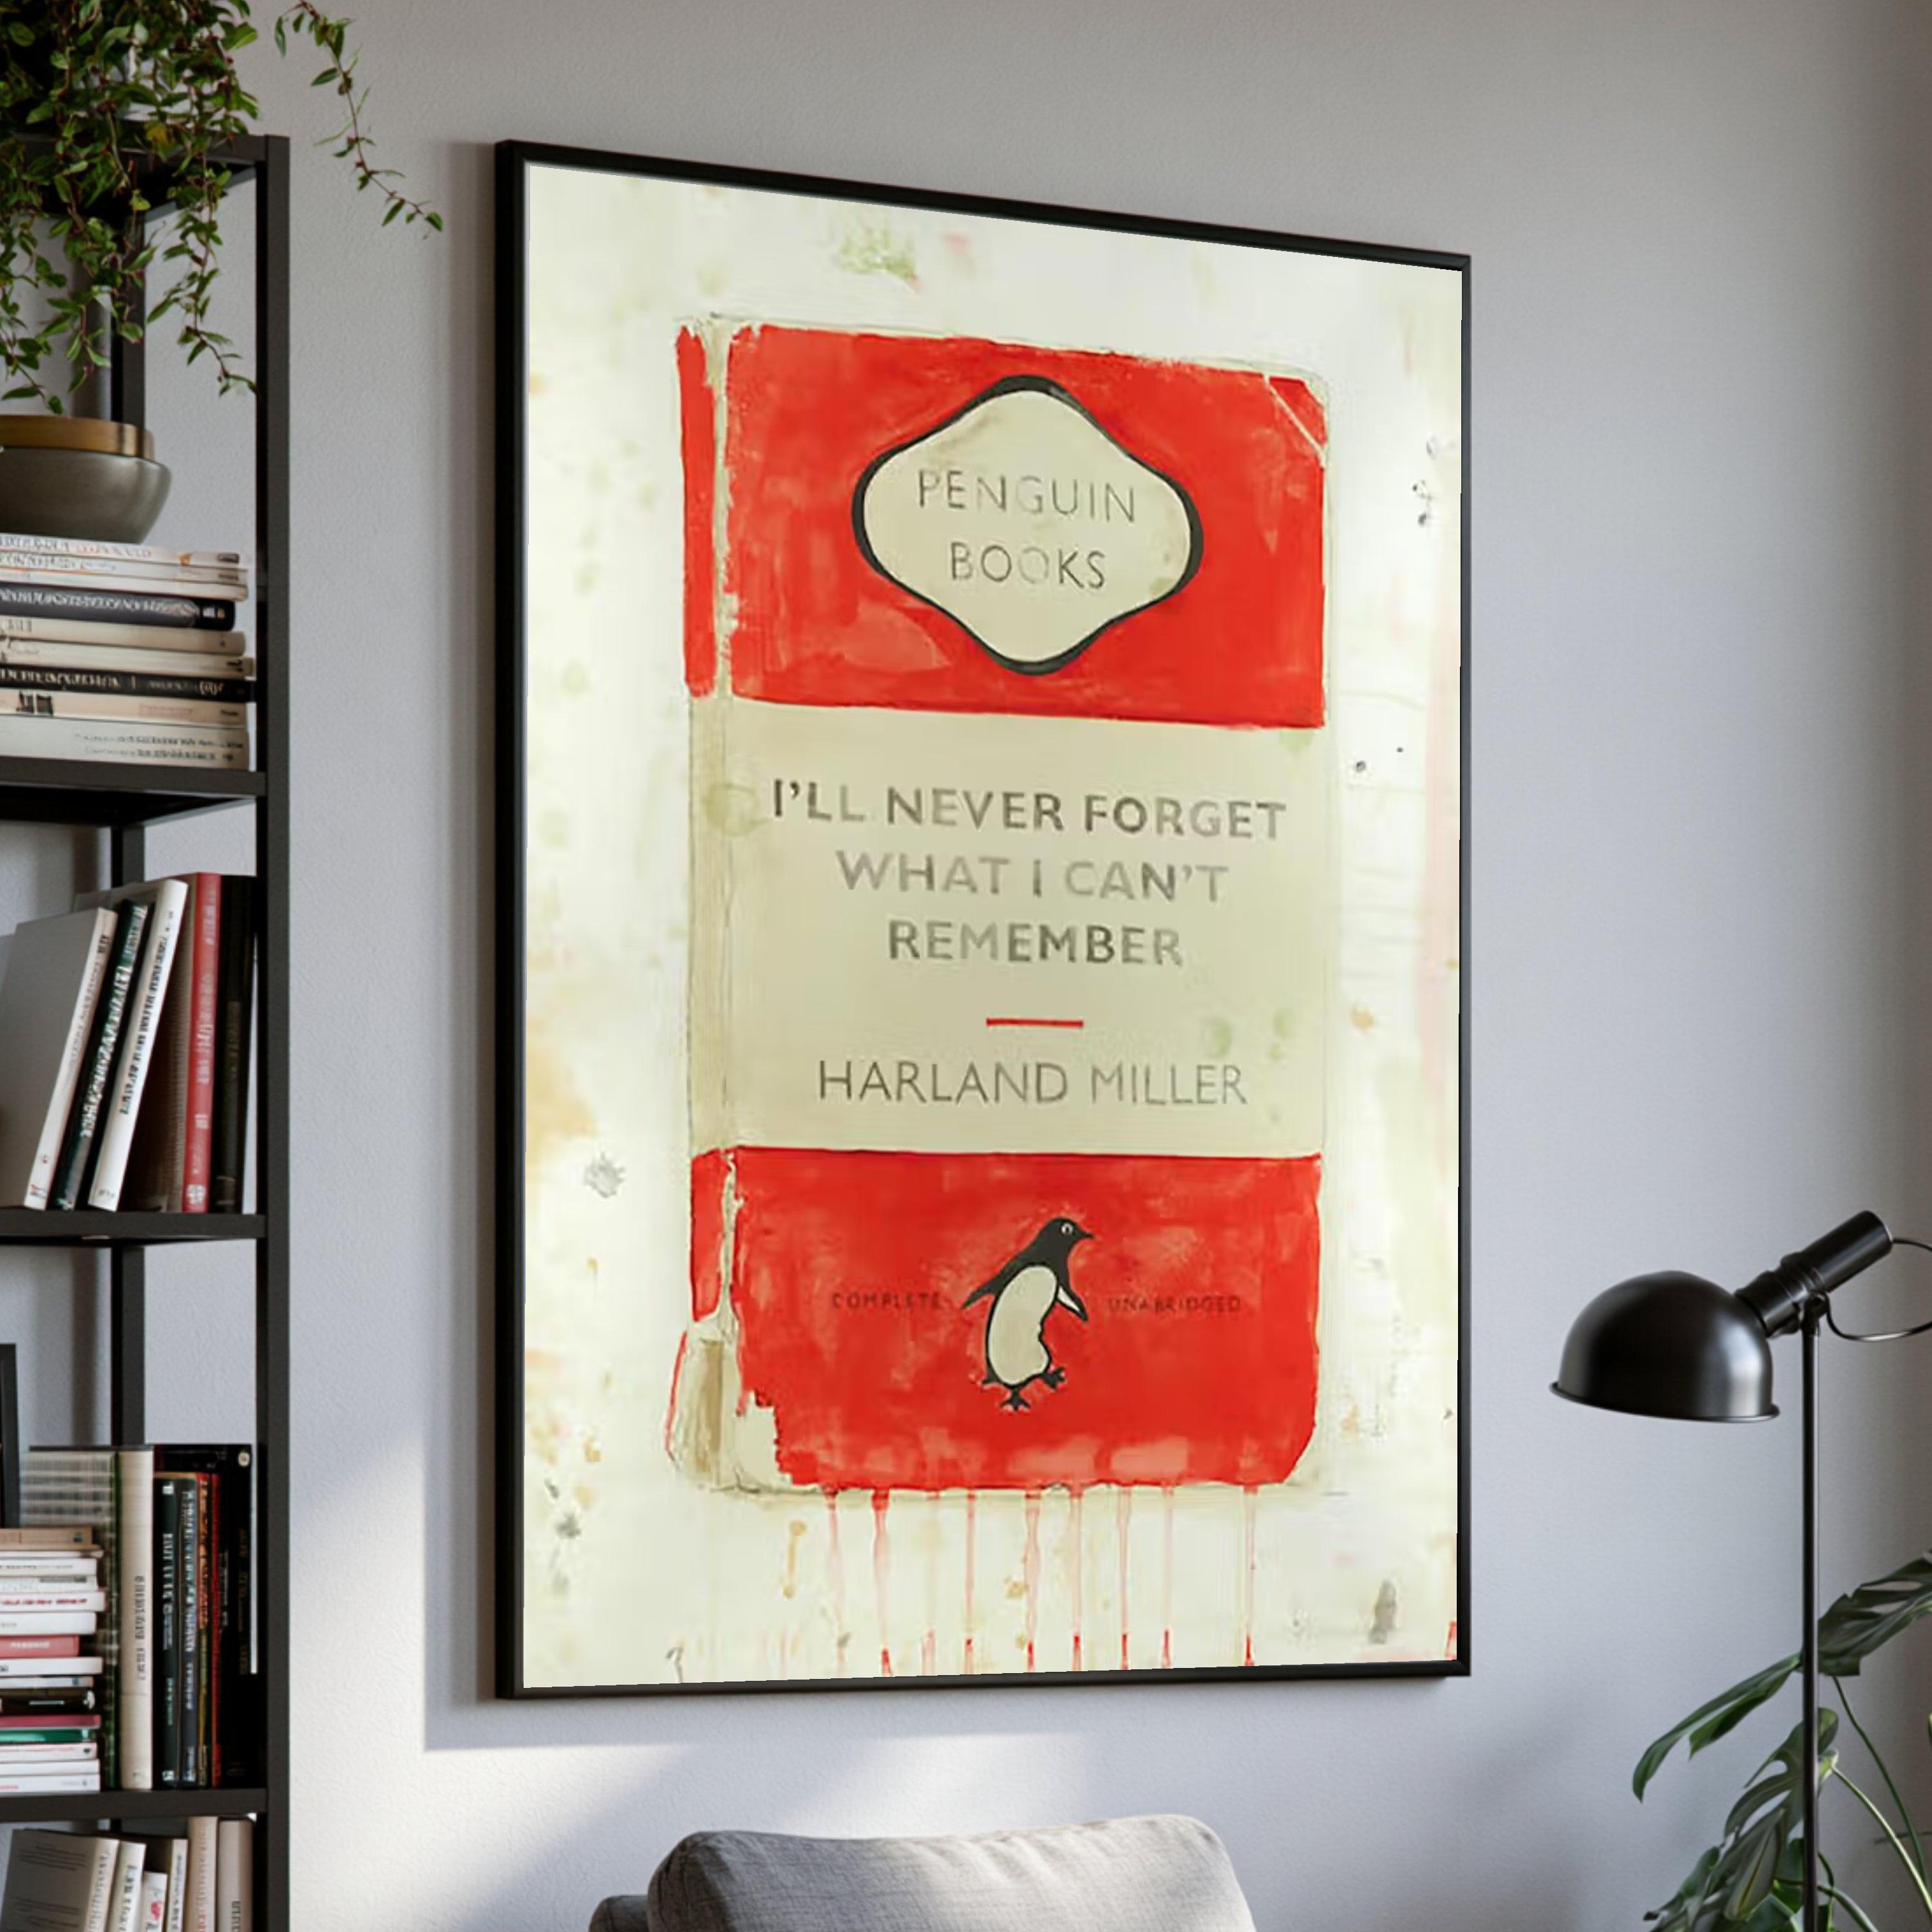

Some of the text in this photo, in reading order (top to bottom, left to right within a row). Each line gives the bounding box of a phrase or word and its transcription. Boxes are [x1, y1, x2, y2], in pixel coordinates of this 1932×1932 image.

[918, 469, 1135, 524] PENGUIN
[950, 541, 1106, 589] BOOKS
[773, 779, 1287, 839] I'LL NEVER FORGET
[836, 849, 1229, 903] WHAT I CAN'T
[889, 920, 1183, 966] REMEMBER
[818, 1058, 1249, 1106] HARLAND MILLER
